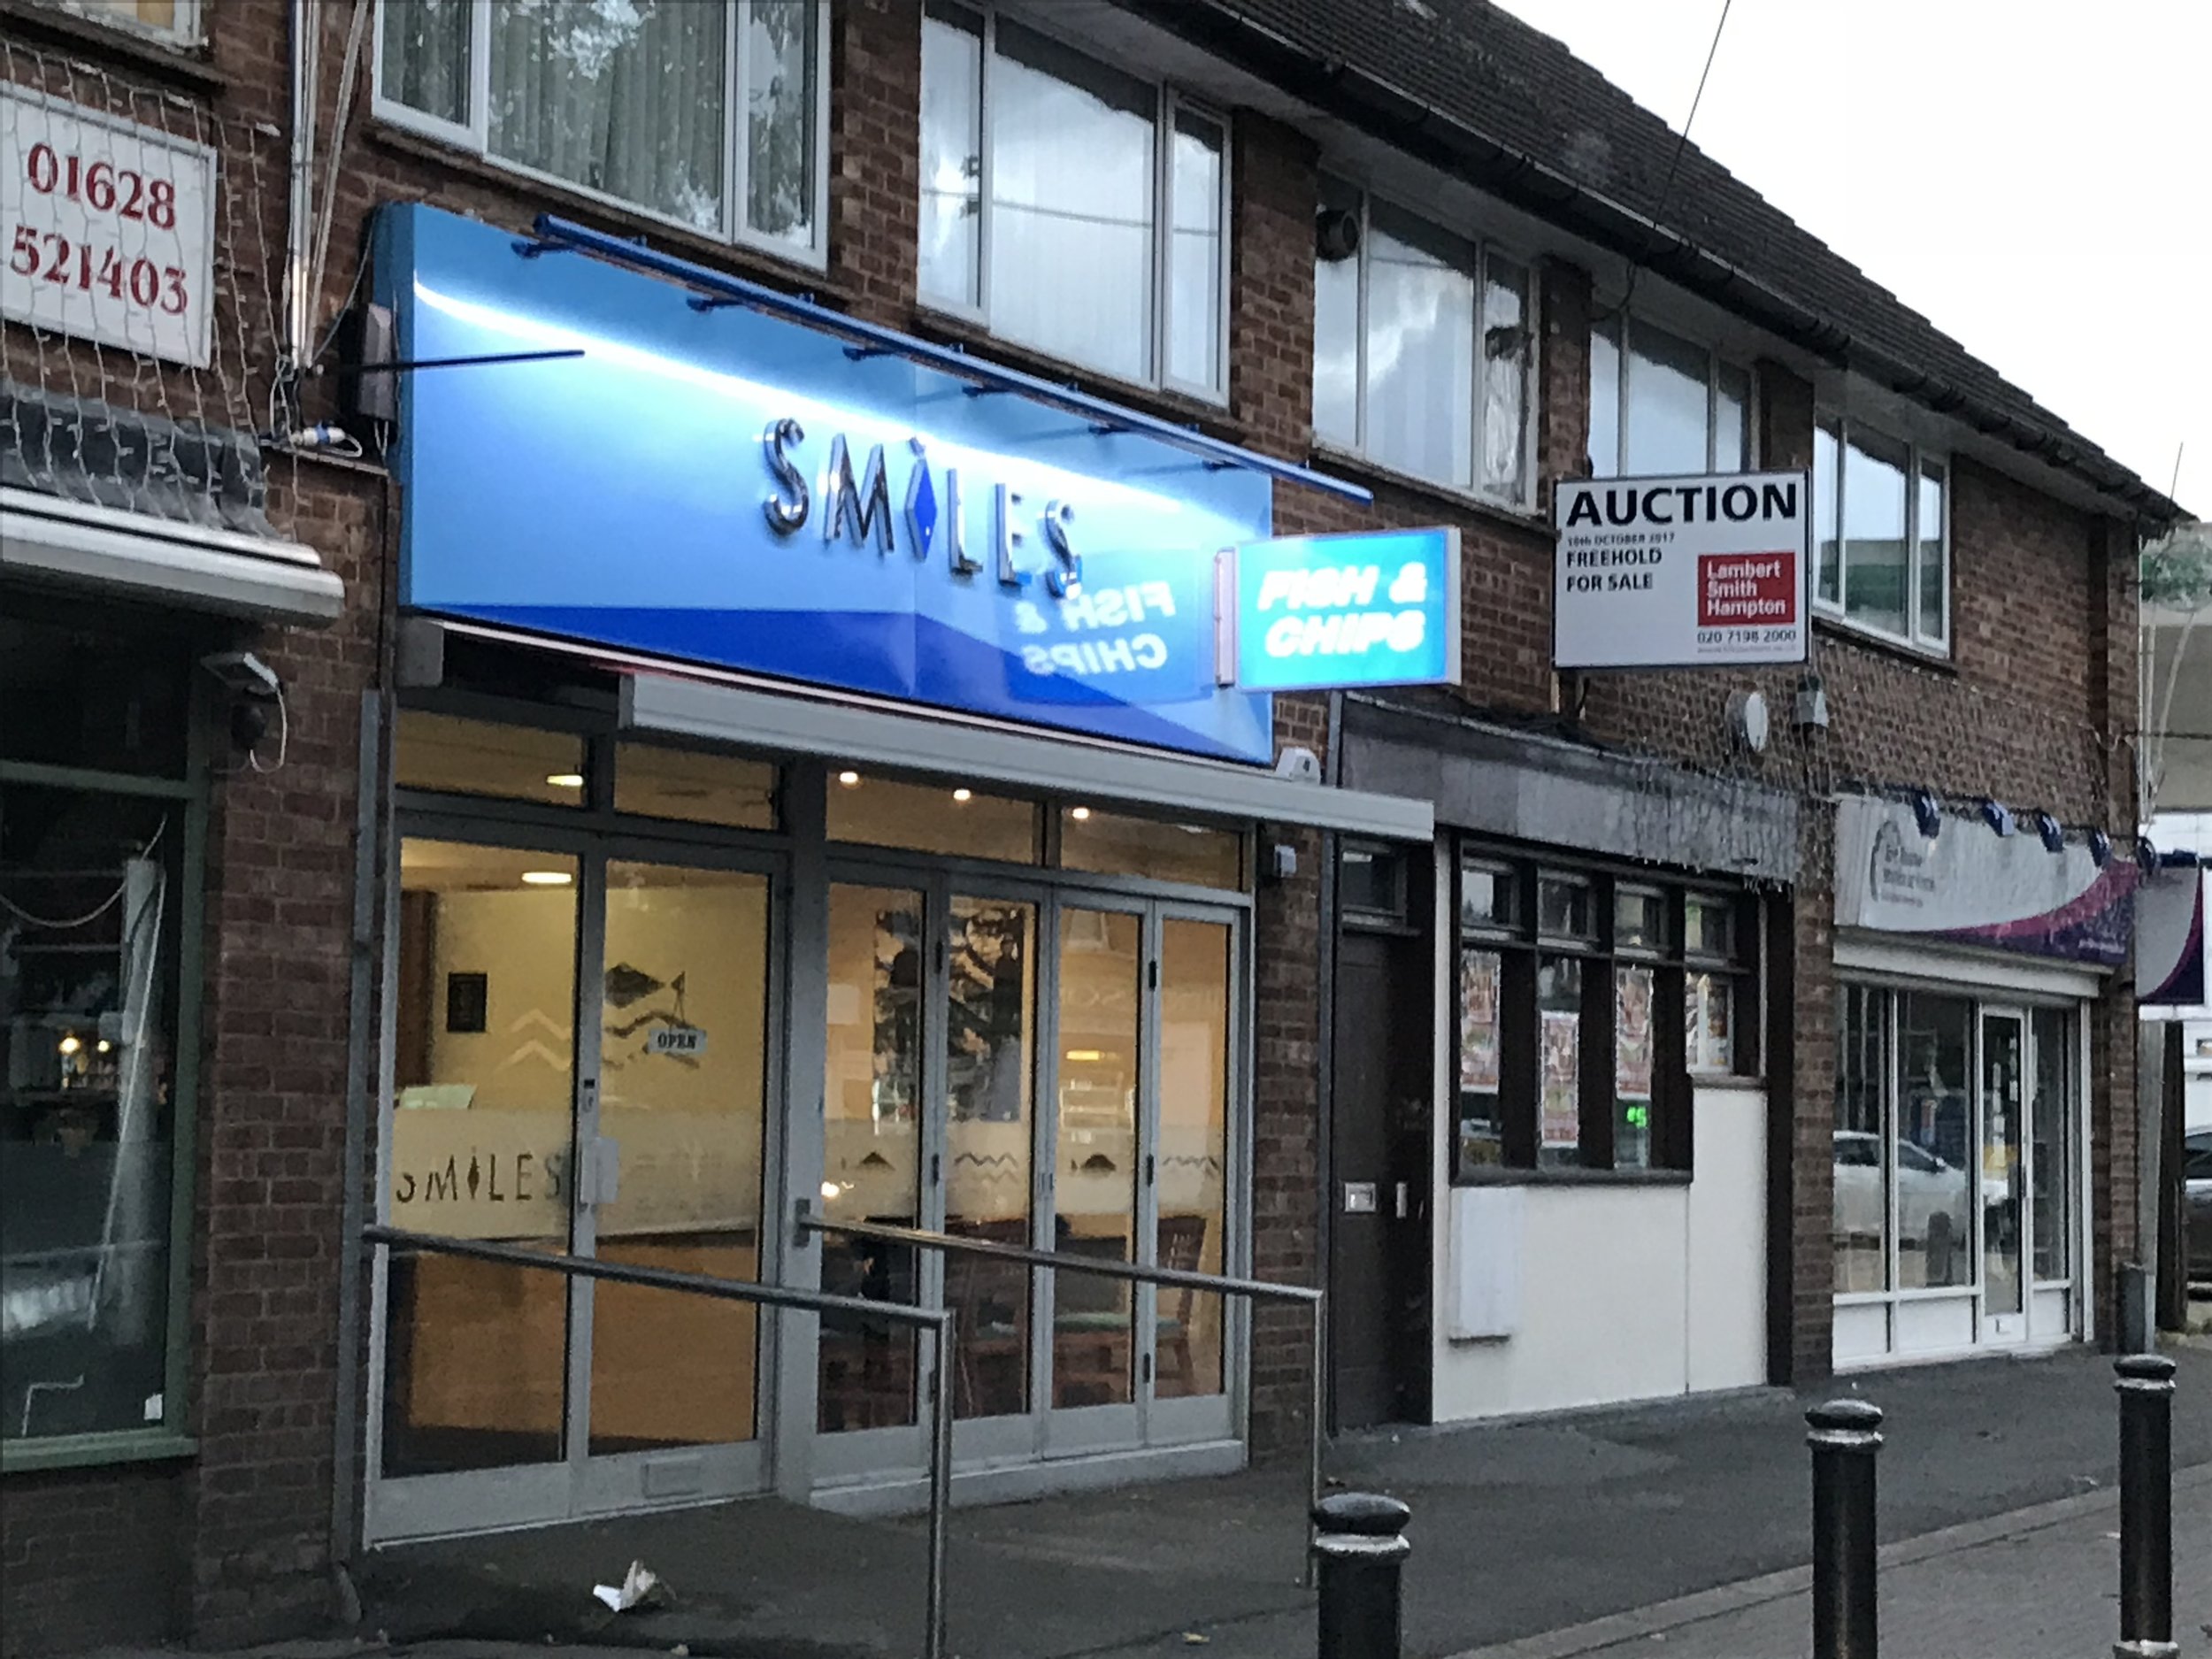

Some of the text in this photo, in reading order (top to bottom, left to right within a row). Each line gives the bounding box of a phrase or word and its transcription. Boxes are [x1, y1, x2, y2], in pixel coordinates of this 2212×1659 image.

[27, 142, 175, 230] 01628
[10, 222, 188, 315] 521403
[764, 418, 1082, 599] SMILES
[1566, 483, 1797, 526] AUCTION
[1594, 534, 1646, 546] OCTOBER
[1567, 548, 1662, 568] FREEHOLD
[1707, 559, 1781, 580] Lambert
[1256, 561, 1427, 611] FISH &
[1567, 572, 1653, 593] FOR SALE
[1707, 579, 1757, 598] Smith
[1707, 597, 1786, 618] Hampton
[1265, 610, 1426, 657] CHIPS
[1697, 631, 1723, 644] 020
[1763, 629, 1796, 642] 2000
[657, 1033, 697, 1049] OPEN
